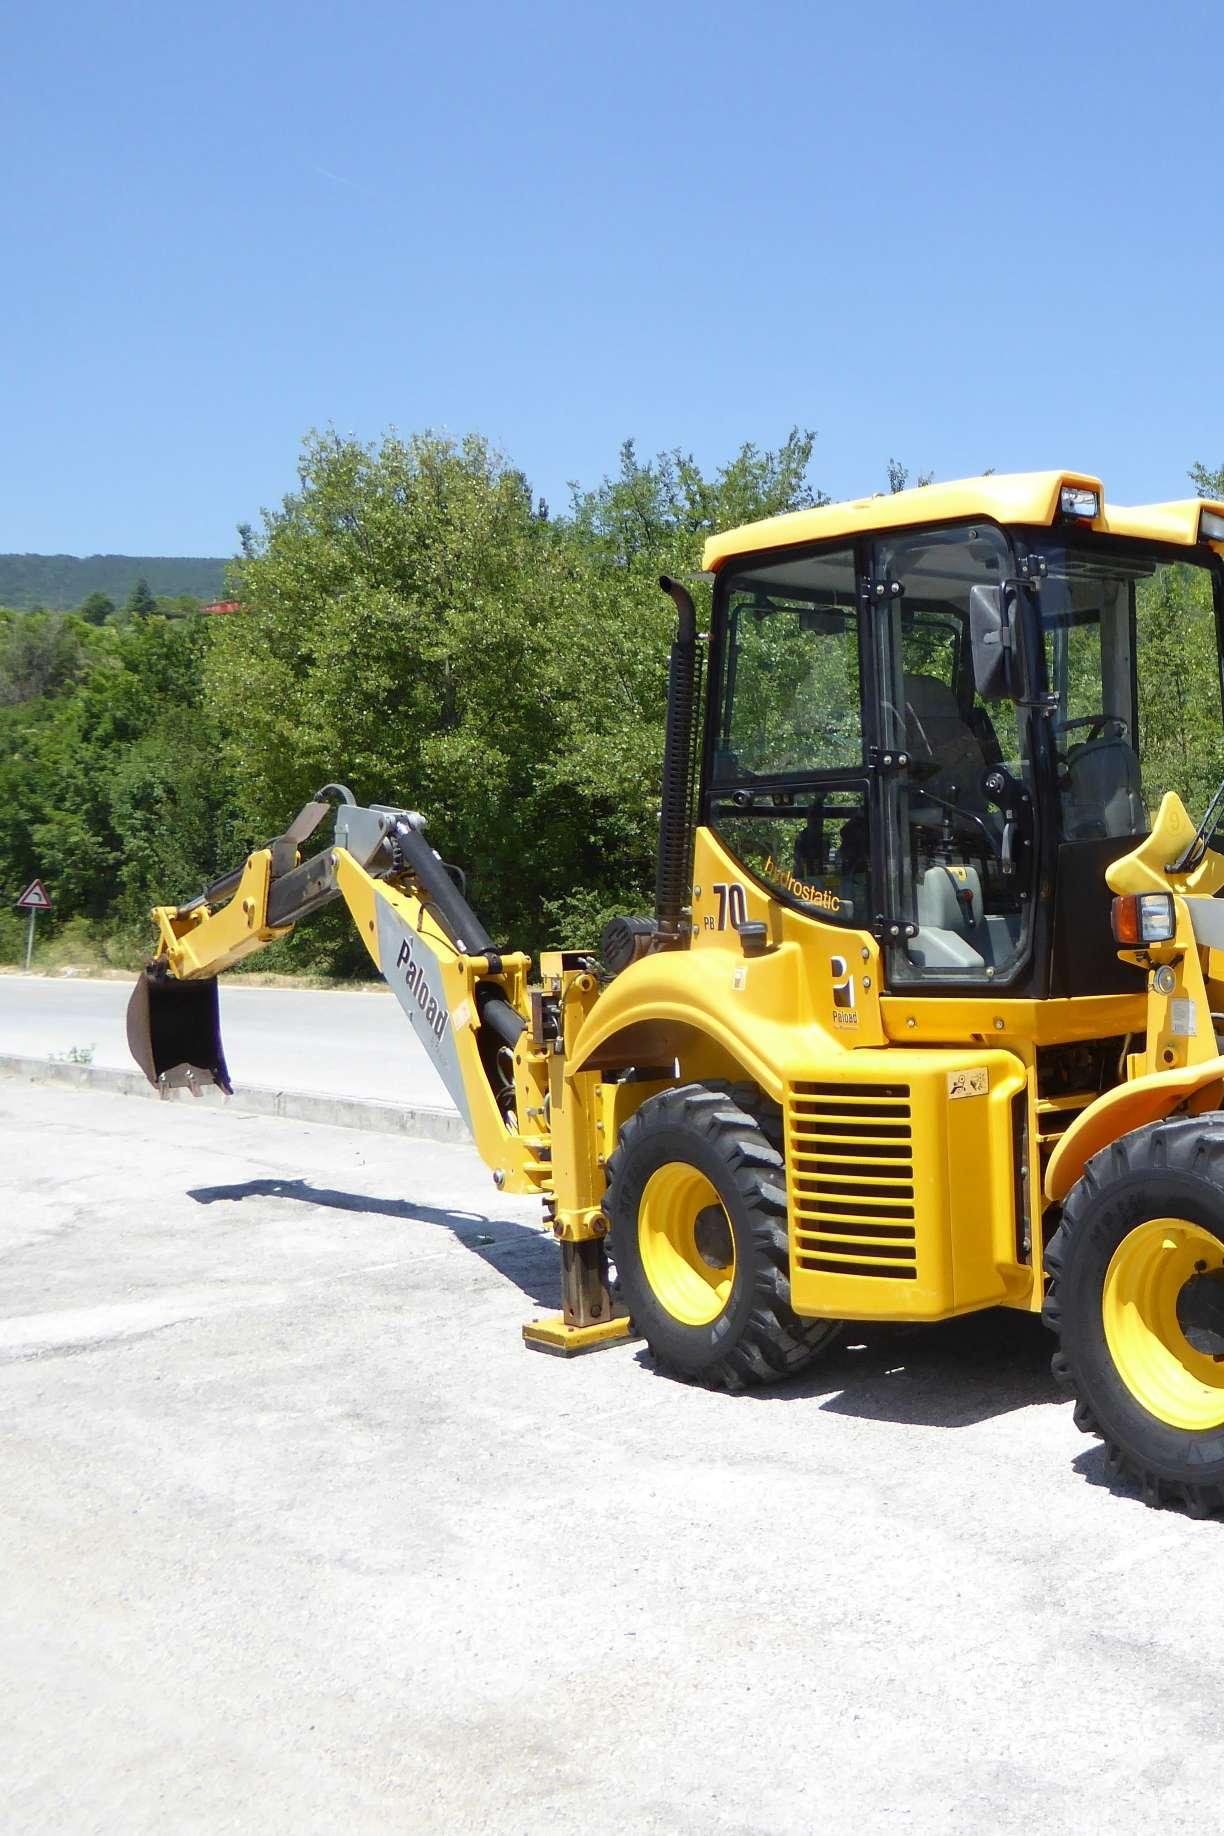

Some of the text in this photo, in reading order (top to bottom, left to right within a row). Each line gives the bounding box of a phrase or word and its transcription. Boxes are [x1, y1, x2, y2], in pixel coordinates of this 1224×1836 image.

[704, 883, 748, 932] PB 70
[397, 937, 448, 1042] Paload
[832, 1010, 858, 1024] Paload
